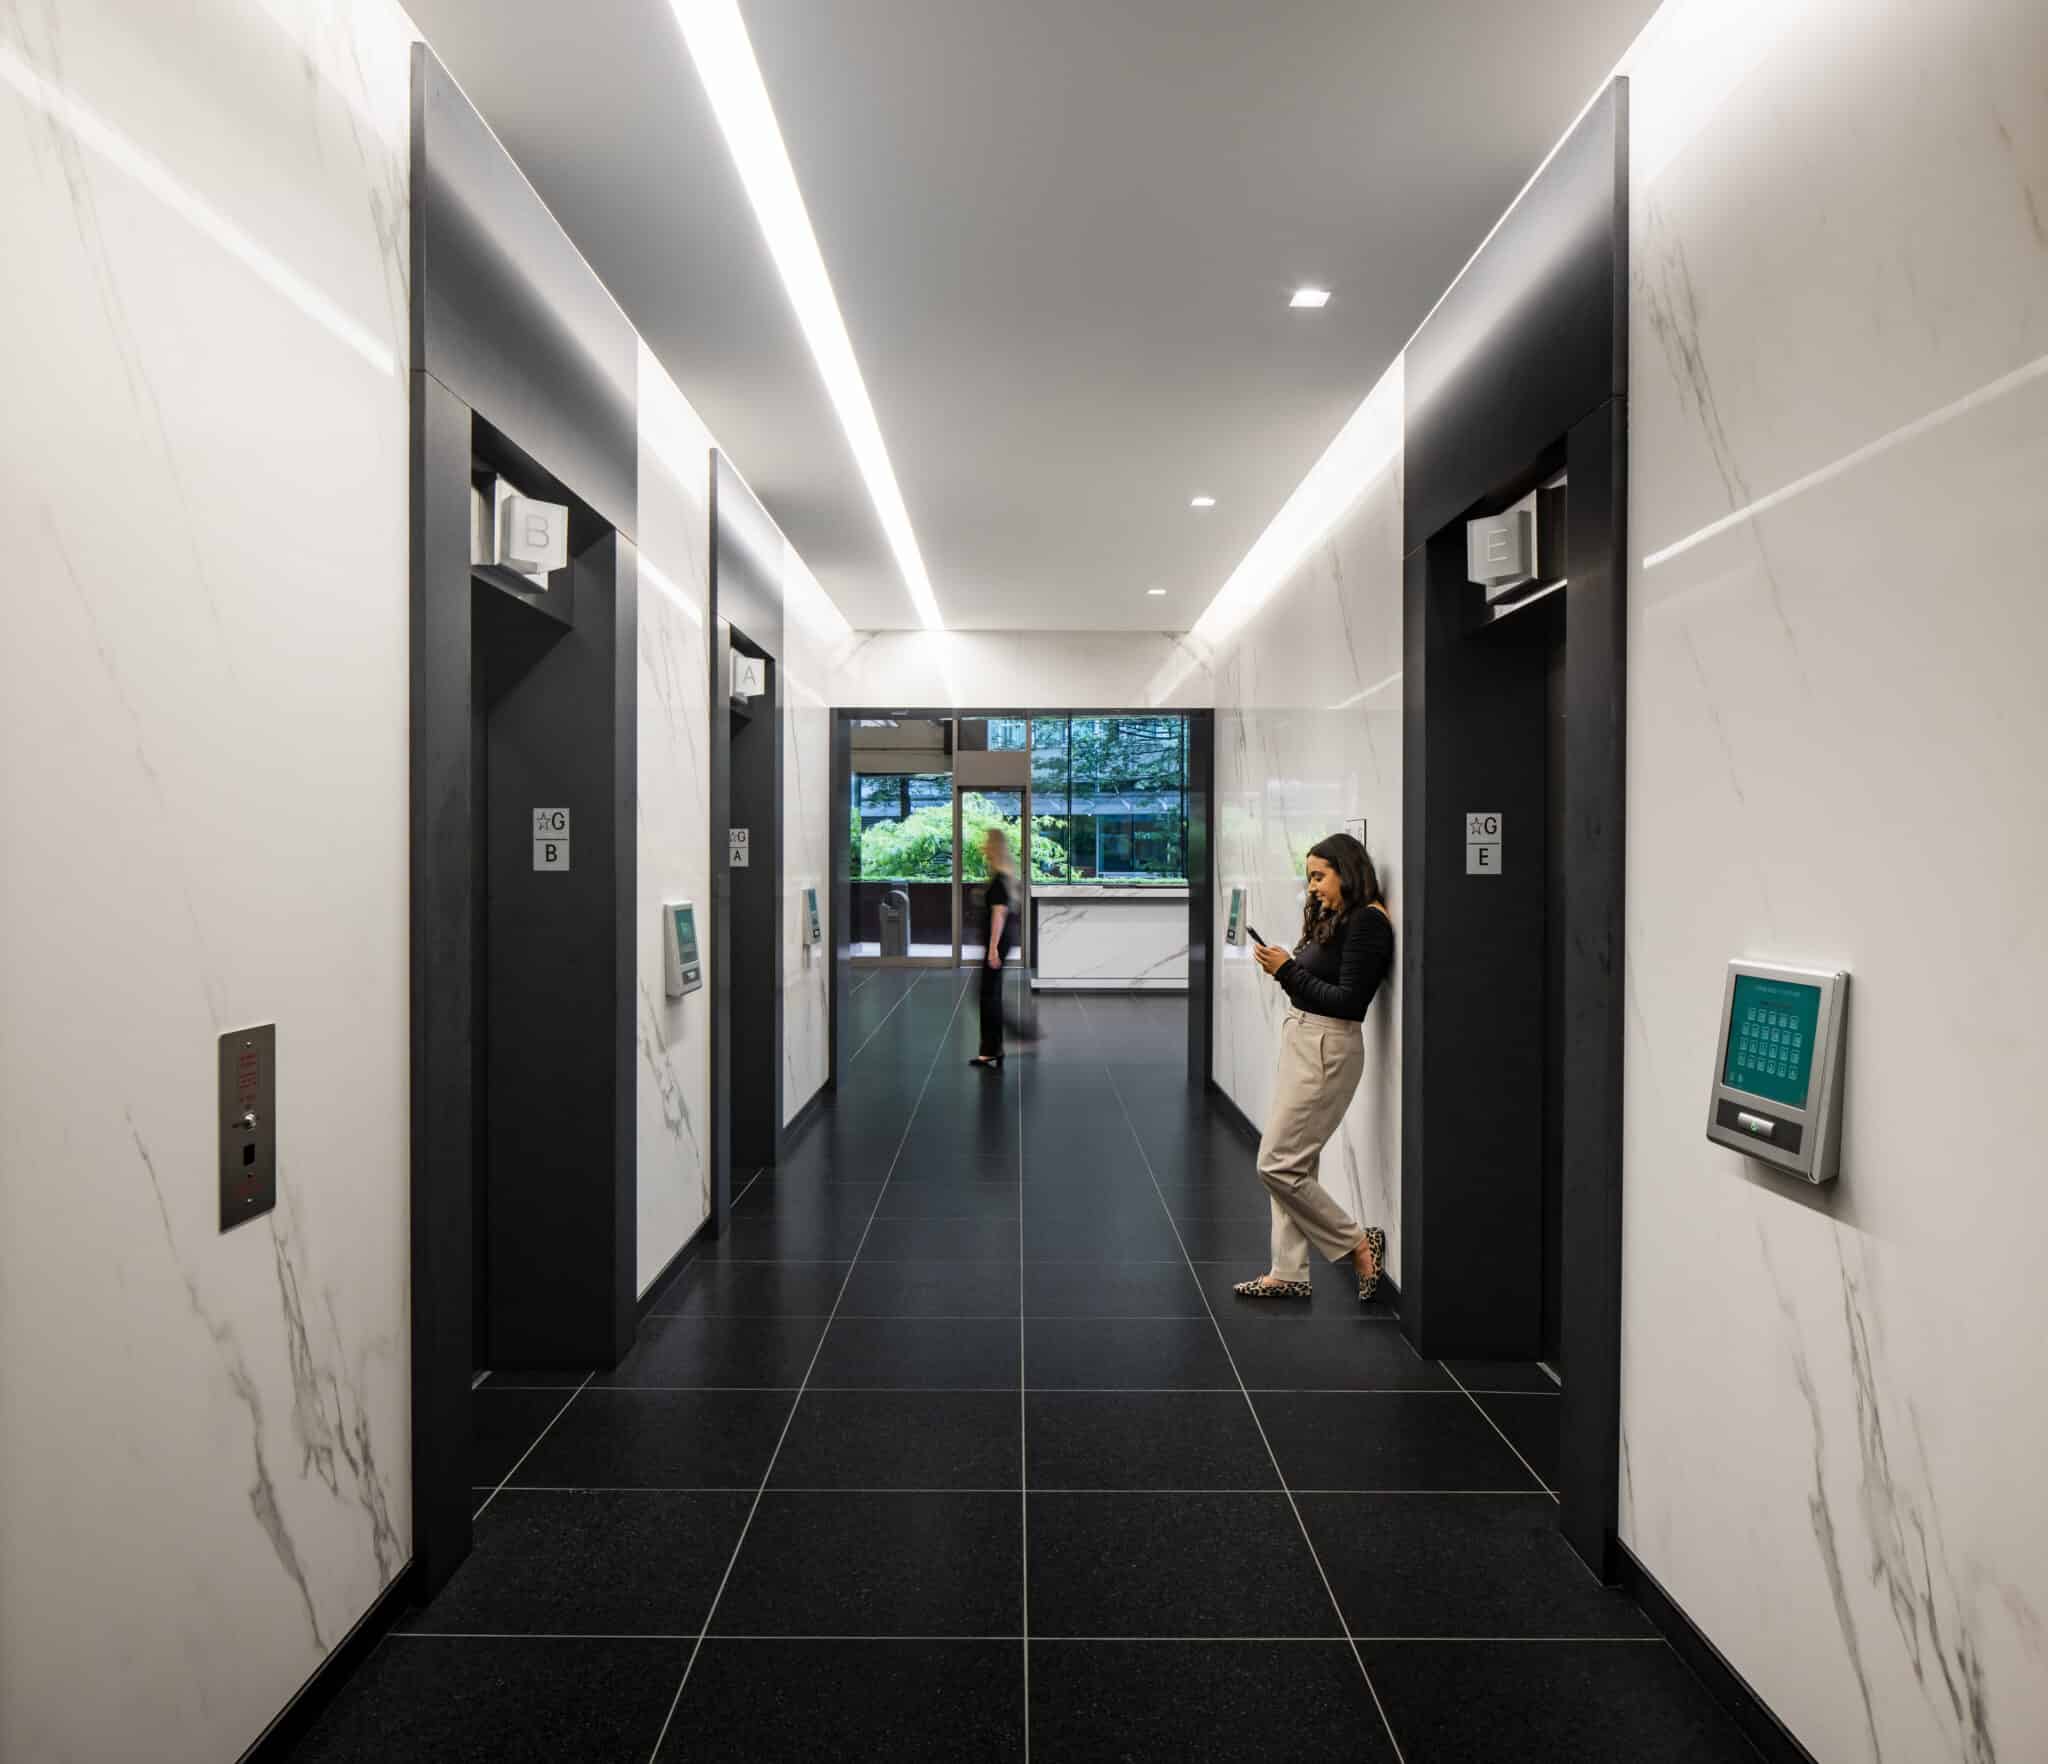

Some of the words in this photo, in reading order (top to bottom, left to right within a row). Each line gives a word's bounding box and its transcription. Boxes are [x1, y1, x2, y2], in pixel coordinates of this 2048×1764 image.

[742, 664, 757, 686] A
[545, 843, 558, 862] B
[734, 849, 742, 861] A
[1479, 847, 1489, 866] E
